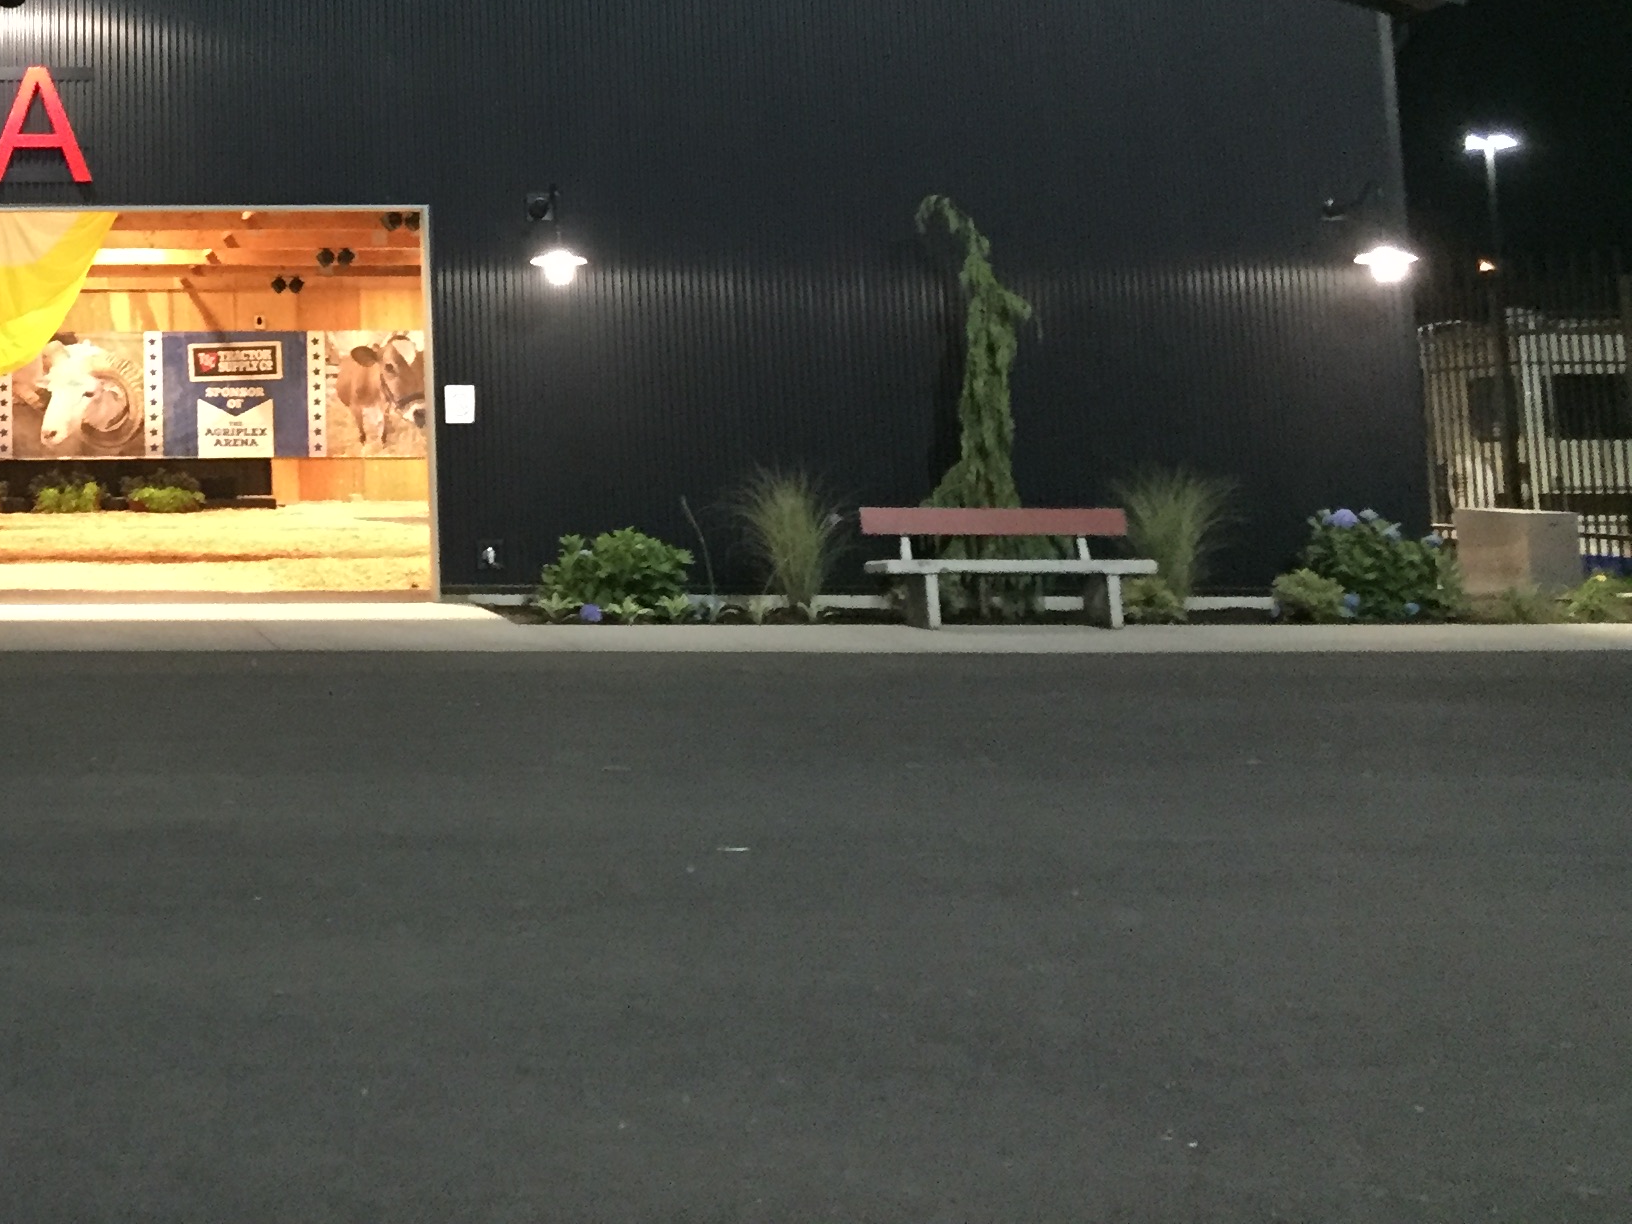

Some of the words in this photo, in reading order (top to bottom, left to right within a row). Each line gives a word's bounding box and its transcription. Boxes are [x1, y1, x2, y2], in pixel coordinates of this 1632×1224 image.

[217, 349, 272, 361] TRACTOR
[218, 361, 258, 372] SUPPLY
[205, 387, 265, 397] SPONSOR
[226, 398, 244, 408] OF
[205, 428, 267, 436] AGRIPLEX
[214, 438, 258, 446] ARENA
